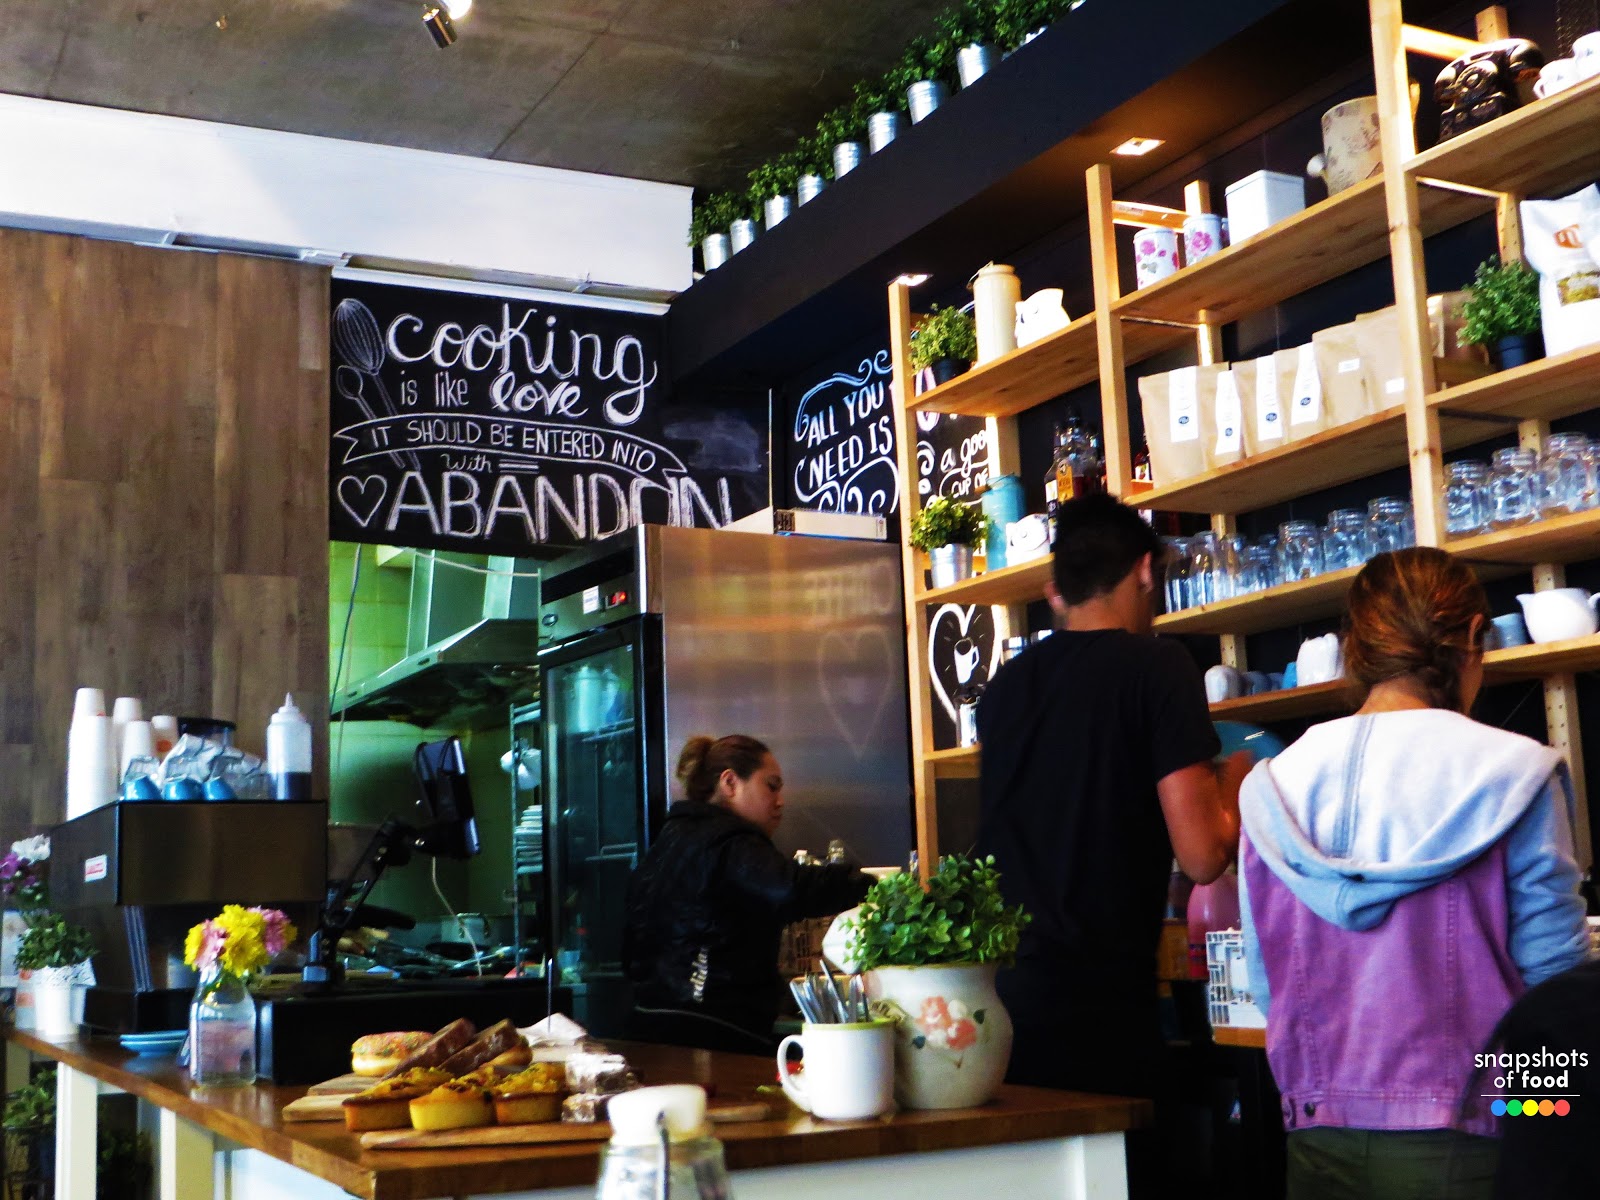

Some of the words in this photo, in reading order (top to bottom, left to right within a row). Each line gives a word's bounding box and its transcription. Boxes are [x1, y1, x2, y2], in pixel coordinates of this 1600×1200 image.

[401, 371, 418, 406] is
[435, 373, 469, 407] like
[489, 371, 589, 418] love
[808, 405, 839, 448] ALL
[843, 381, 885, 427] YOU
[371, 425, 392, 449] IT
[407, 419, 482, 445] SHOULD
[490, 424, 515, 446] BE
[522, 427, 606, 460] ENTERED
[611, 442, 656, 473] INTO
[808, 434, 864, 490] NEED
[869, 415, 893, 456] IS
[960, 429, 989, 479] goo
[385, 470, 732, 543] ABANDON
